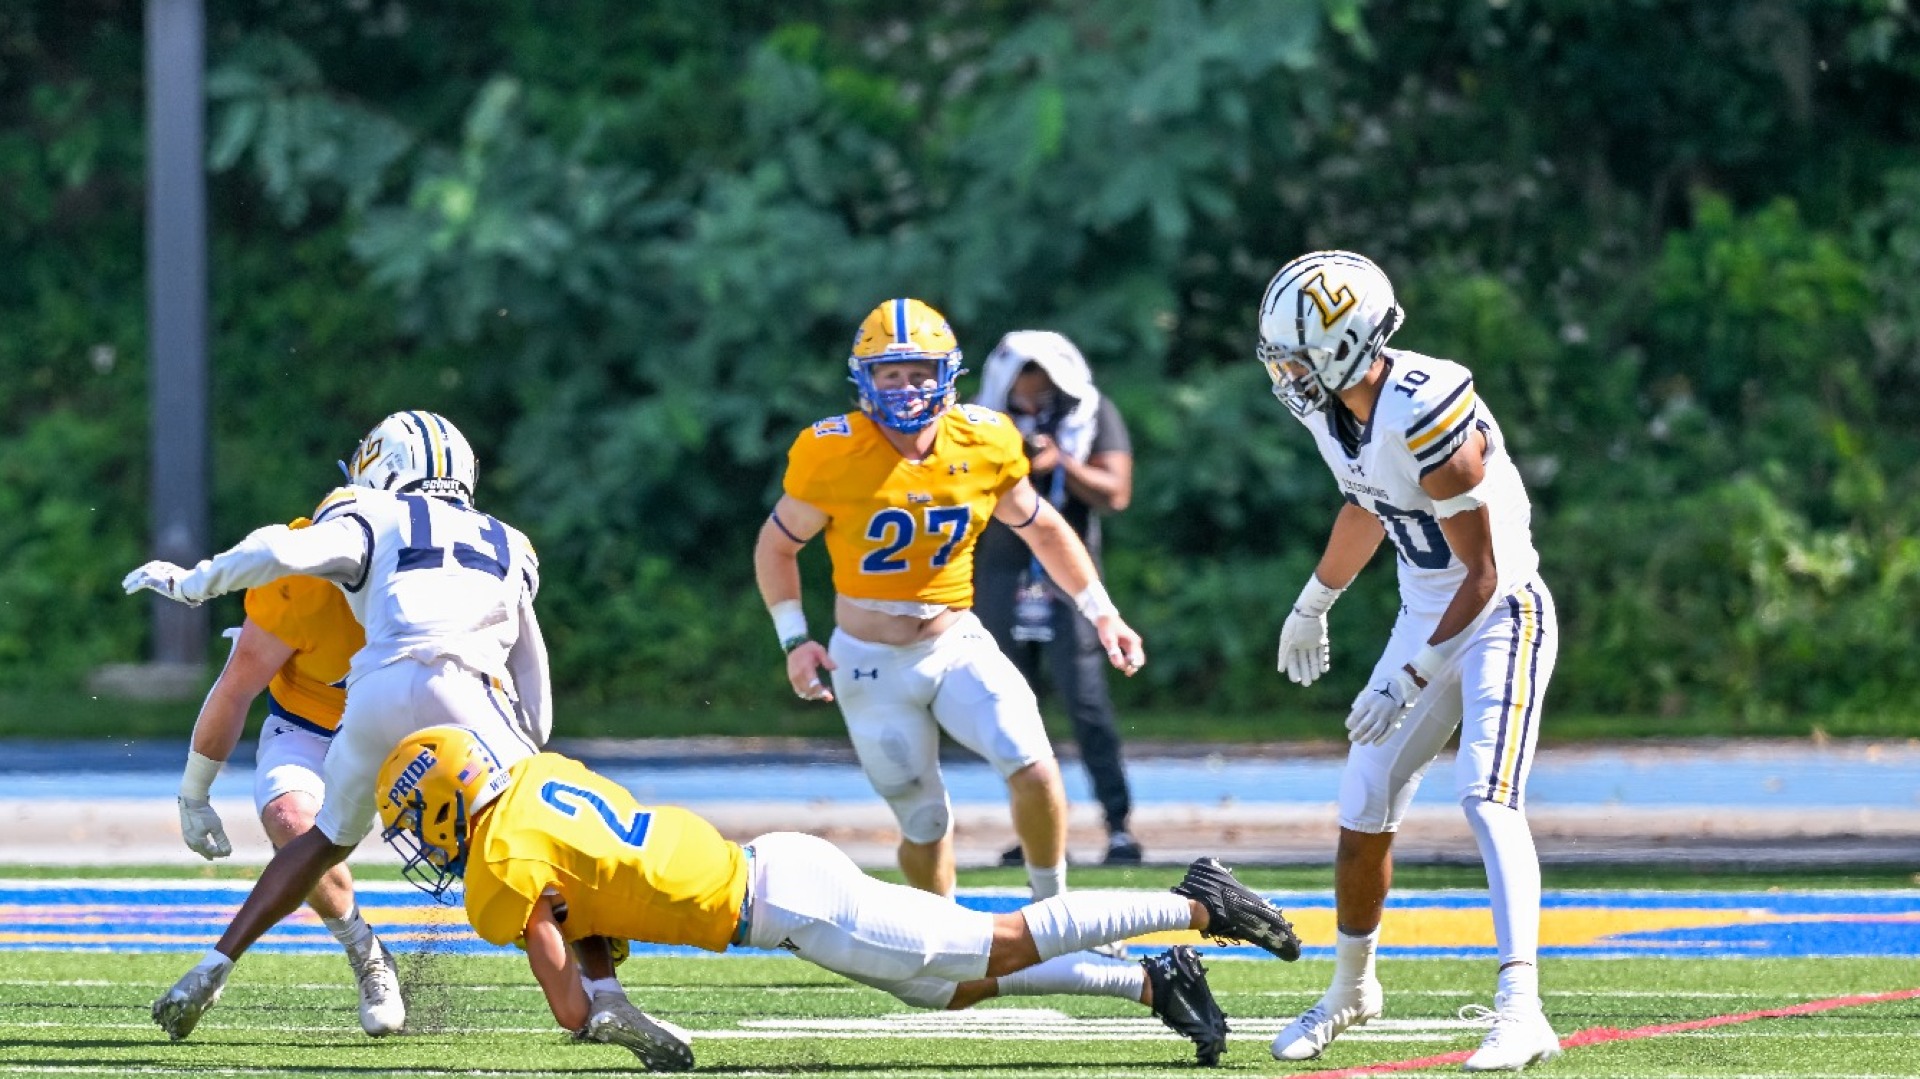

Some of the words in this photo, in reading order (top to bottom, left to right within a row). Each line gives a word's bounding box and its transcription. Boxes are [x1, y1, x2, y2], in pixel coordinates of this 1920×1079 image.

[1301, 271, 1358, 331] L
[1393, 369, 1431, 399] 10
[394, 491, 511, 582] 13
[858, 505, 972, 575] 27
[388, 749, 438, 808] PRIDE
[537, 778, 655, 851] 2
